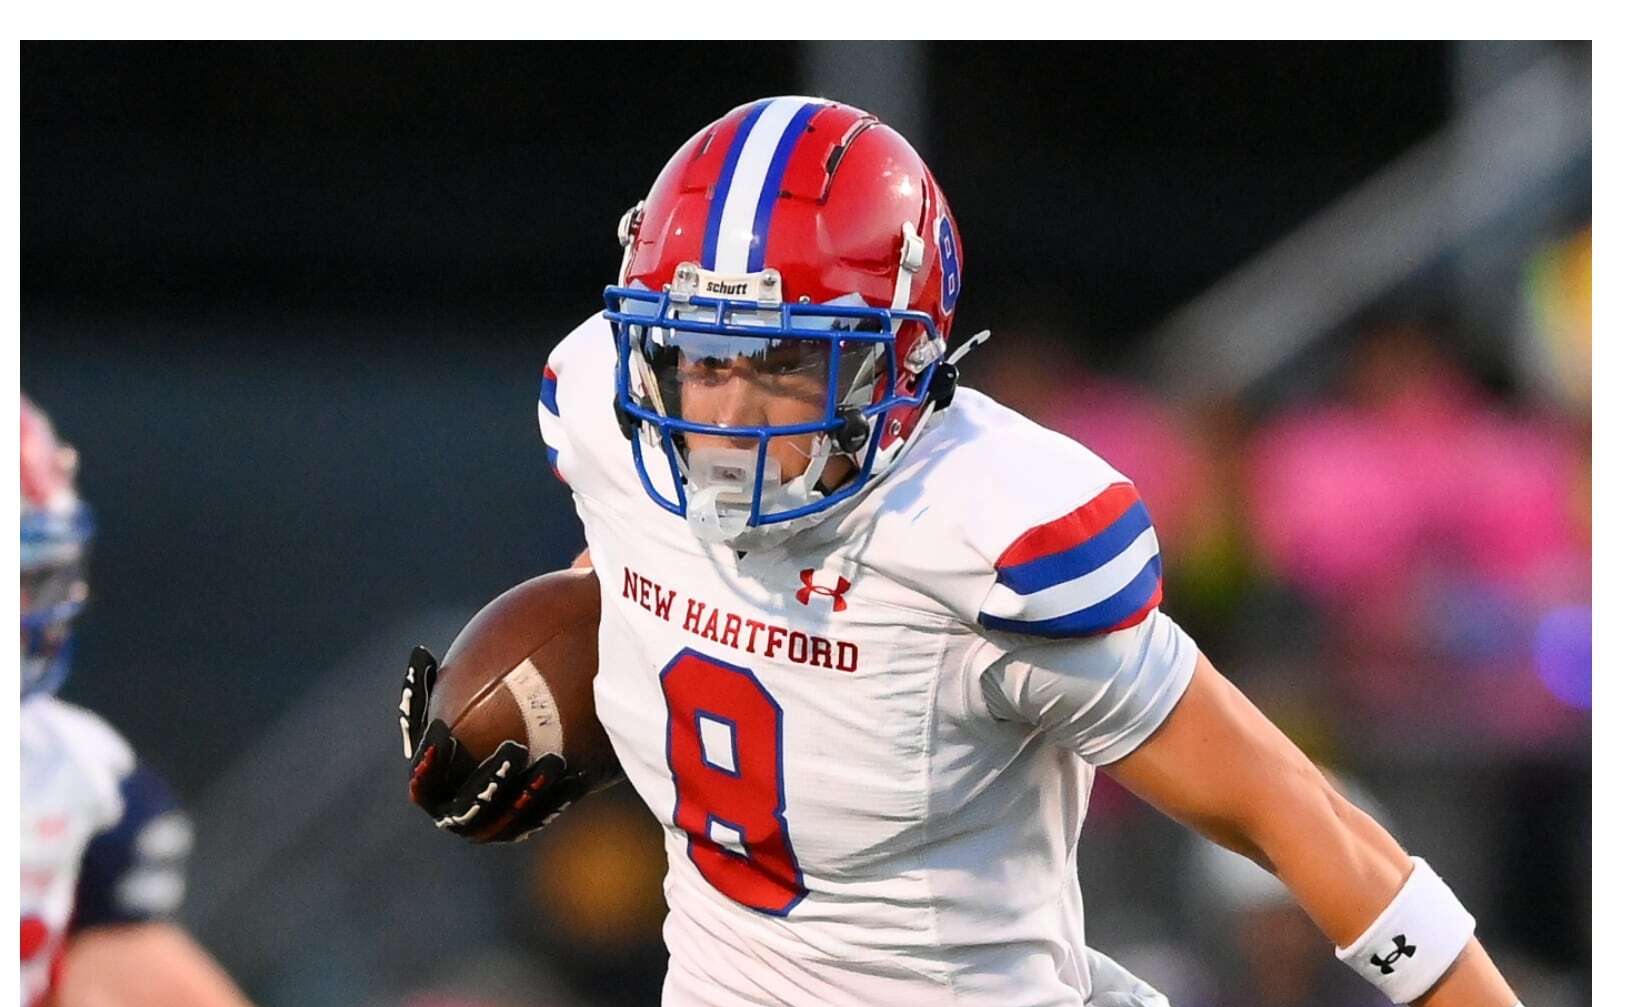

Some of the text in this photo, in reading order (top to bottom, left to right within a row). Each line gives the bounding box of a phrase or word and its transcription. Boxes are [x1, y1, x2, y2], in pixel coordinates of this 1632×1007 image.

[706, 280, 748, 295] schutt
[937, 215, 961, 316] 8
[622, 566, 858, 673] NEW HARTFORD
[659, 646, 809, 918] 8
